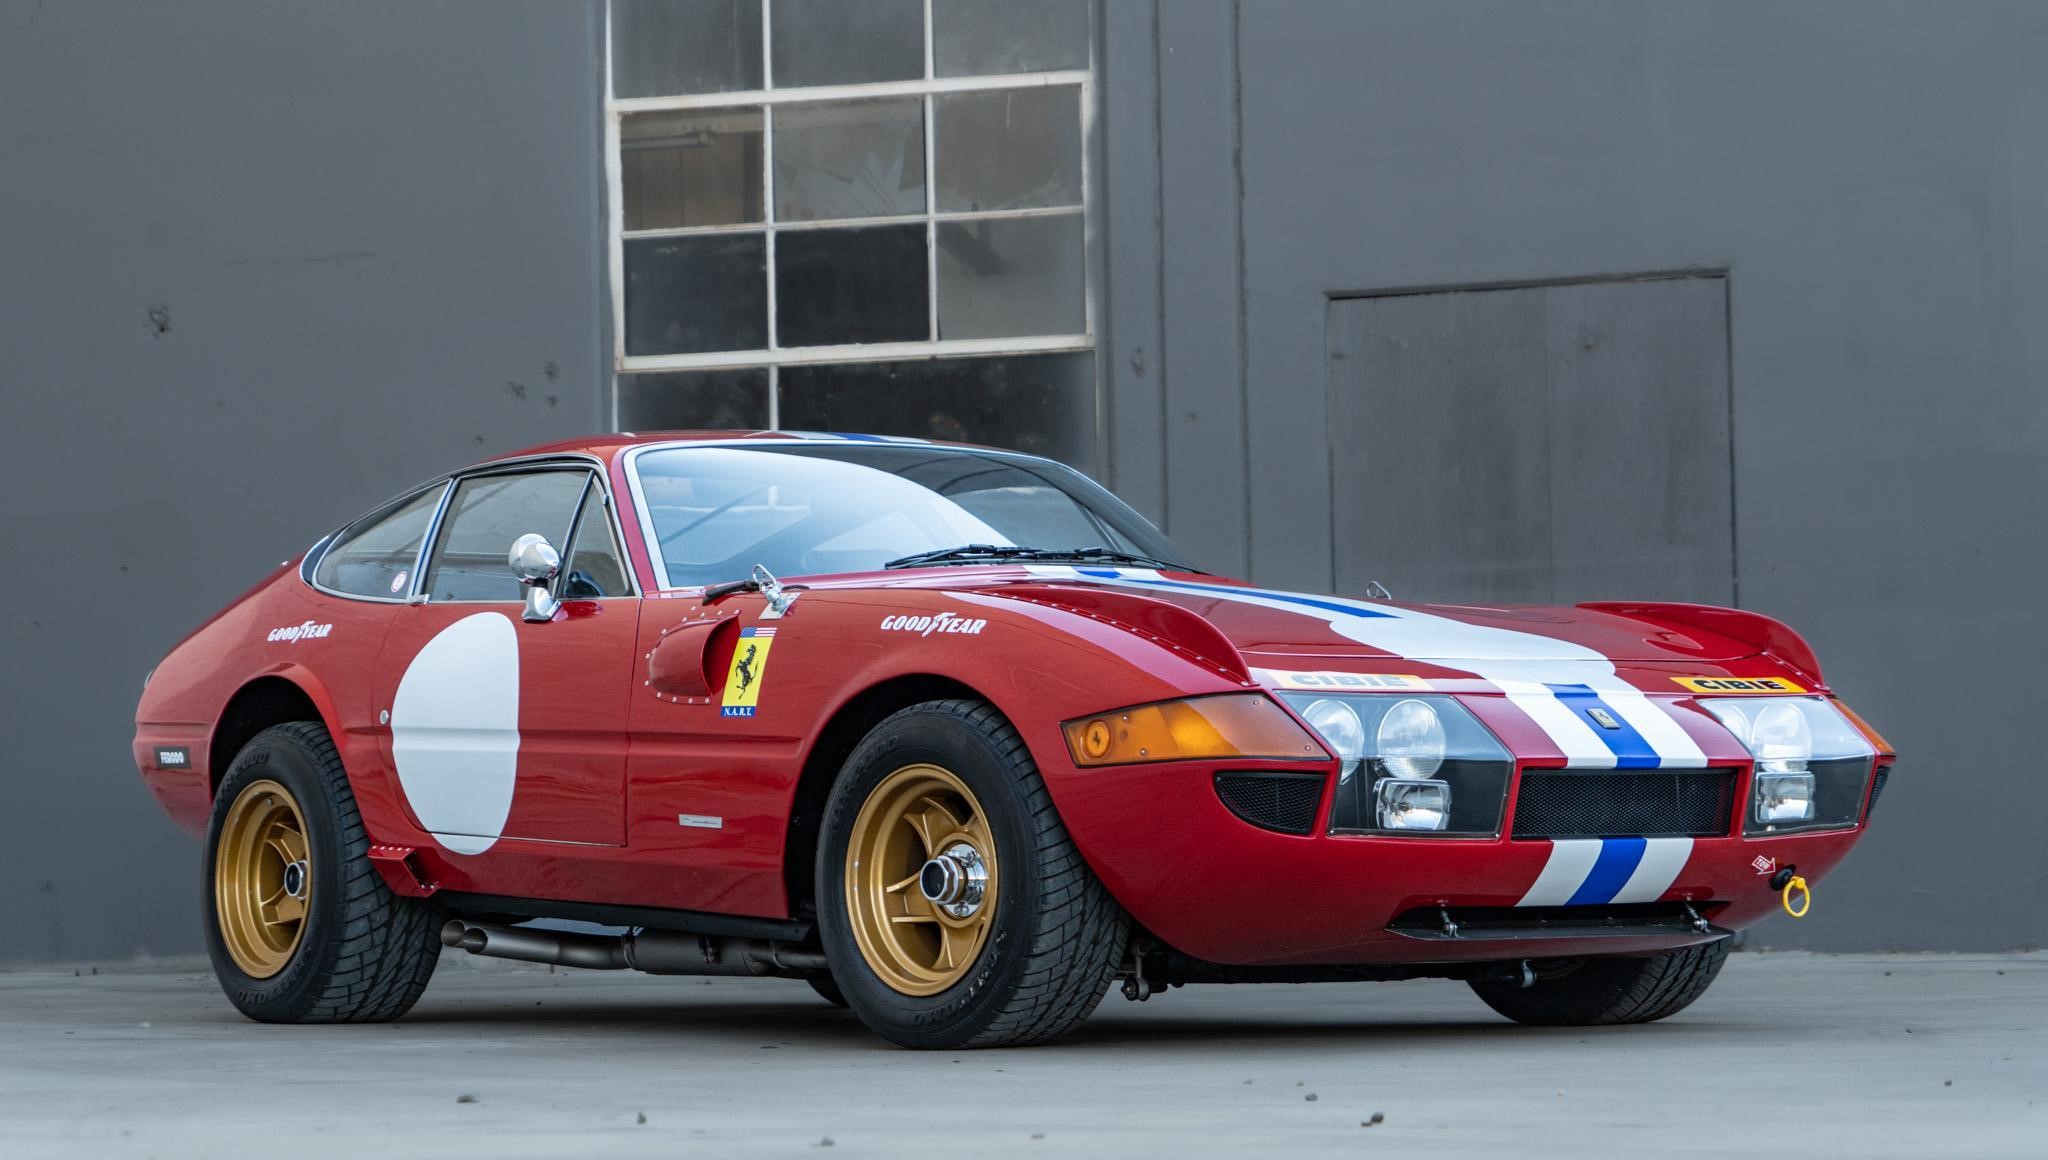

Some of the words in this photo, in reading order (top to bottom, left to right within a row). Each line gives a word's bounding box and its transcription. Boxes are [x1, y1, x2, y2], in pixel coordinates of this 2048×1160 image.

[267, 620, 333, 644] GOODYEAR
[880, 611, 987, 637] GOODYEAR
[160, 751, 184, 764] FERODO
